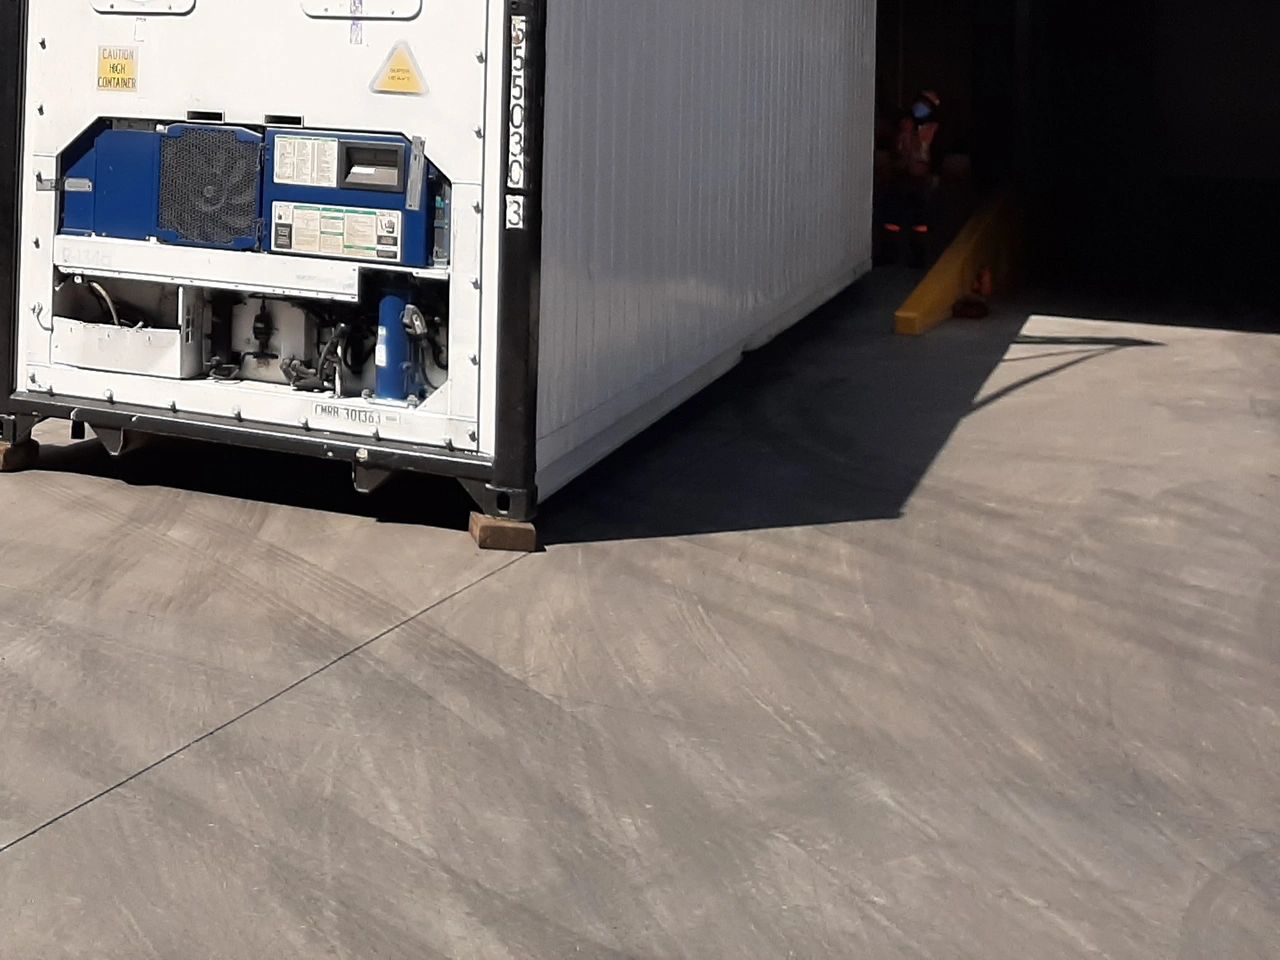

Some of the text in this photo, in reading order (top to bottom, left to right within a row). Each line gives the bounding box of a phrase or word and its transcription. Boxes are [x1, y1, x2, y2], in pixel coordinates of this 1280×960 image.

[102, 48, 135, 60] CAUTION
[109, 63, 126, 74] HIGH
[97, 76, 136, 88] CONTAINER
[508, 17, 529, 186] 555030
[507, 200, 522, 226] 3
